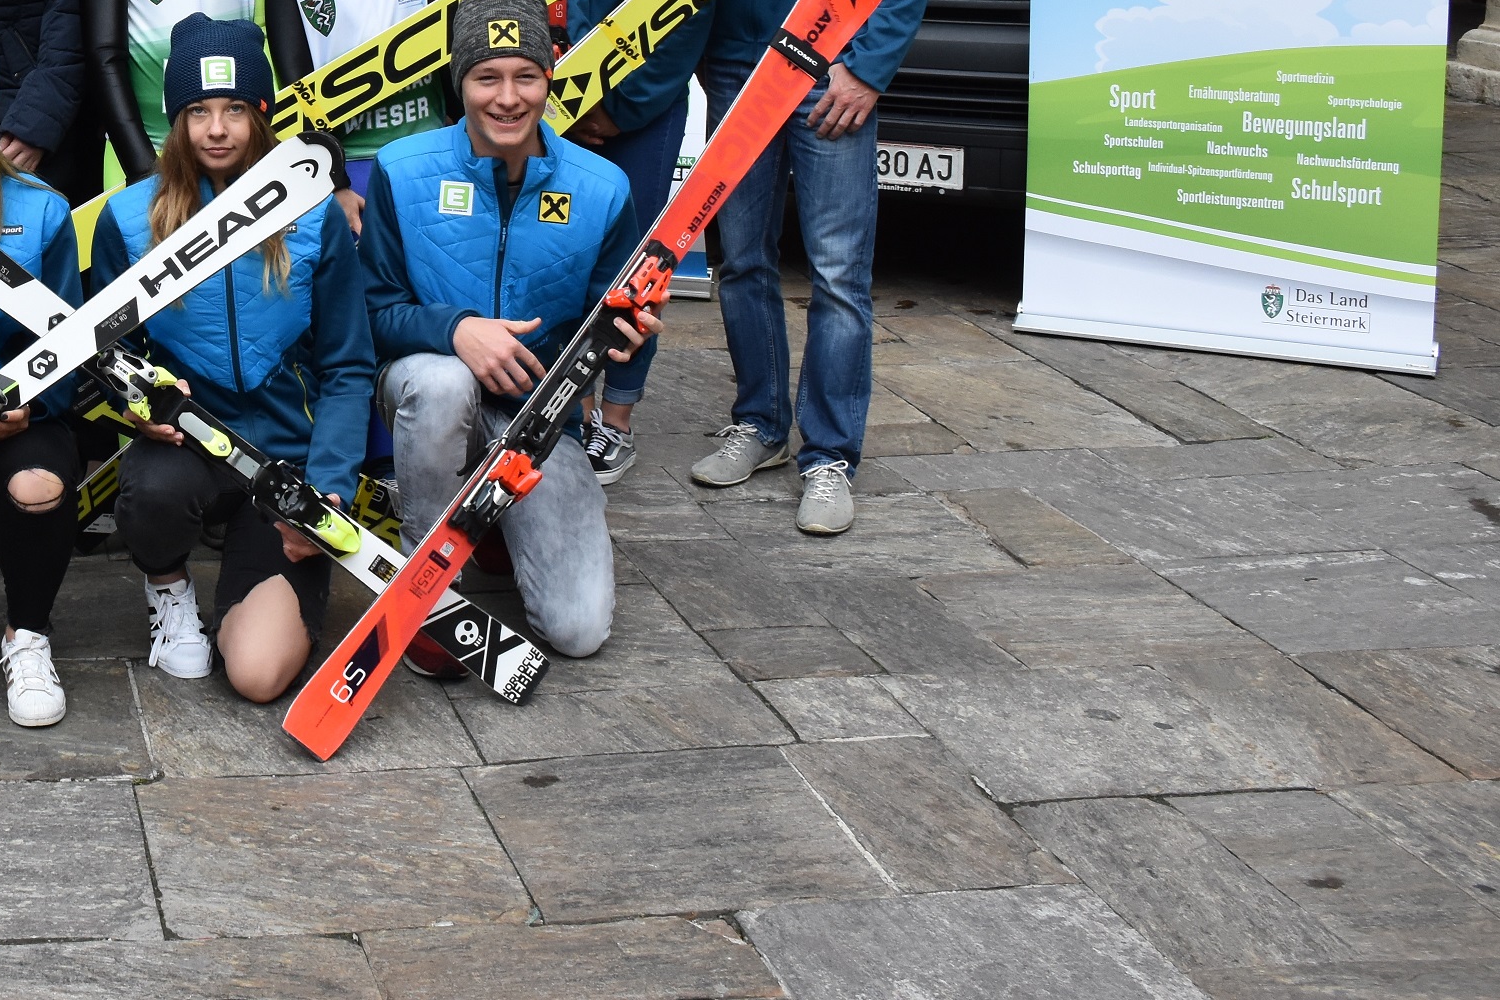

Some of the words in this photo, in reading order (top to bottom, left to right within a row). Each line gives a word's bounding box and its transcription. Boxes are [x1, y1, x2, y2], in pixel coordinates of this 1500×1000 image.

[615, 36, 640, 61] TOKO
[786, 43, 818, 68] ATOMIC
[1276, 70, 1335, 85] Sportmedizin
[1109, 84, 1156, 113] Sport
[1188, 85, 1281, 106] Ernährungsberatung
[1327, 95, 1403, 111] Sportpsychologie
[344, 96, 430, 135] WIESER
[1124, 116, 1223, 133] Landessportorganisation
[1242, 111, 1367, 142] Bewegungsland
[1103, 134, 1164, 150] Sportschulen
[1206, 141, 1268, 158] Nachwuchs
[915, 152, 953, 181] AJ
[1072, 160, 1142, 180] Schulsporttag
[1148, 161, 1274, 183] Individual-Spitzensportförderung
[1296, 153, 1400, 174] Nachwuchsförderung
[1176, 188, 1285, 211] Sportleistungszentren
[1290, 177, 1382, 208] Schulsport
[687, 180, 727, 234] REDSTER
[138, 180, 288, 299] HEAD
[676, 231, 692, 249] S9
[1295, 288, 1324, 305] Das
[1329, 291, 1368, 309] Land
[1286, 308, 1367, 330] Steiermark
[329, 660, 367, 704] S9
